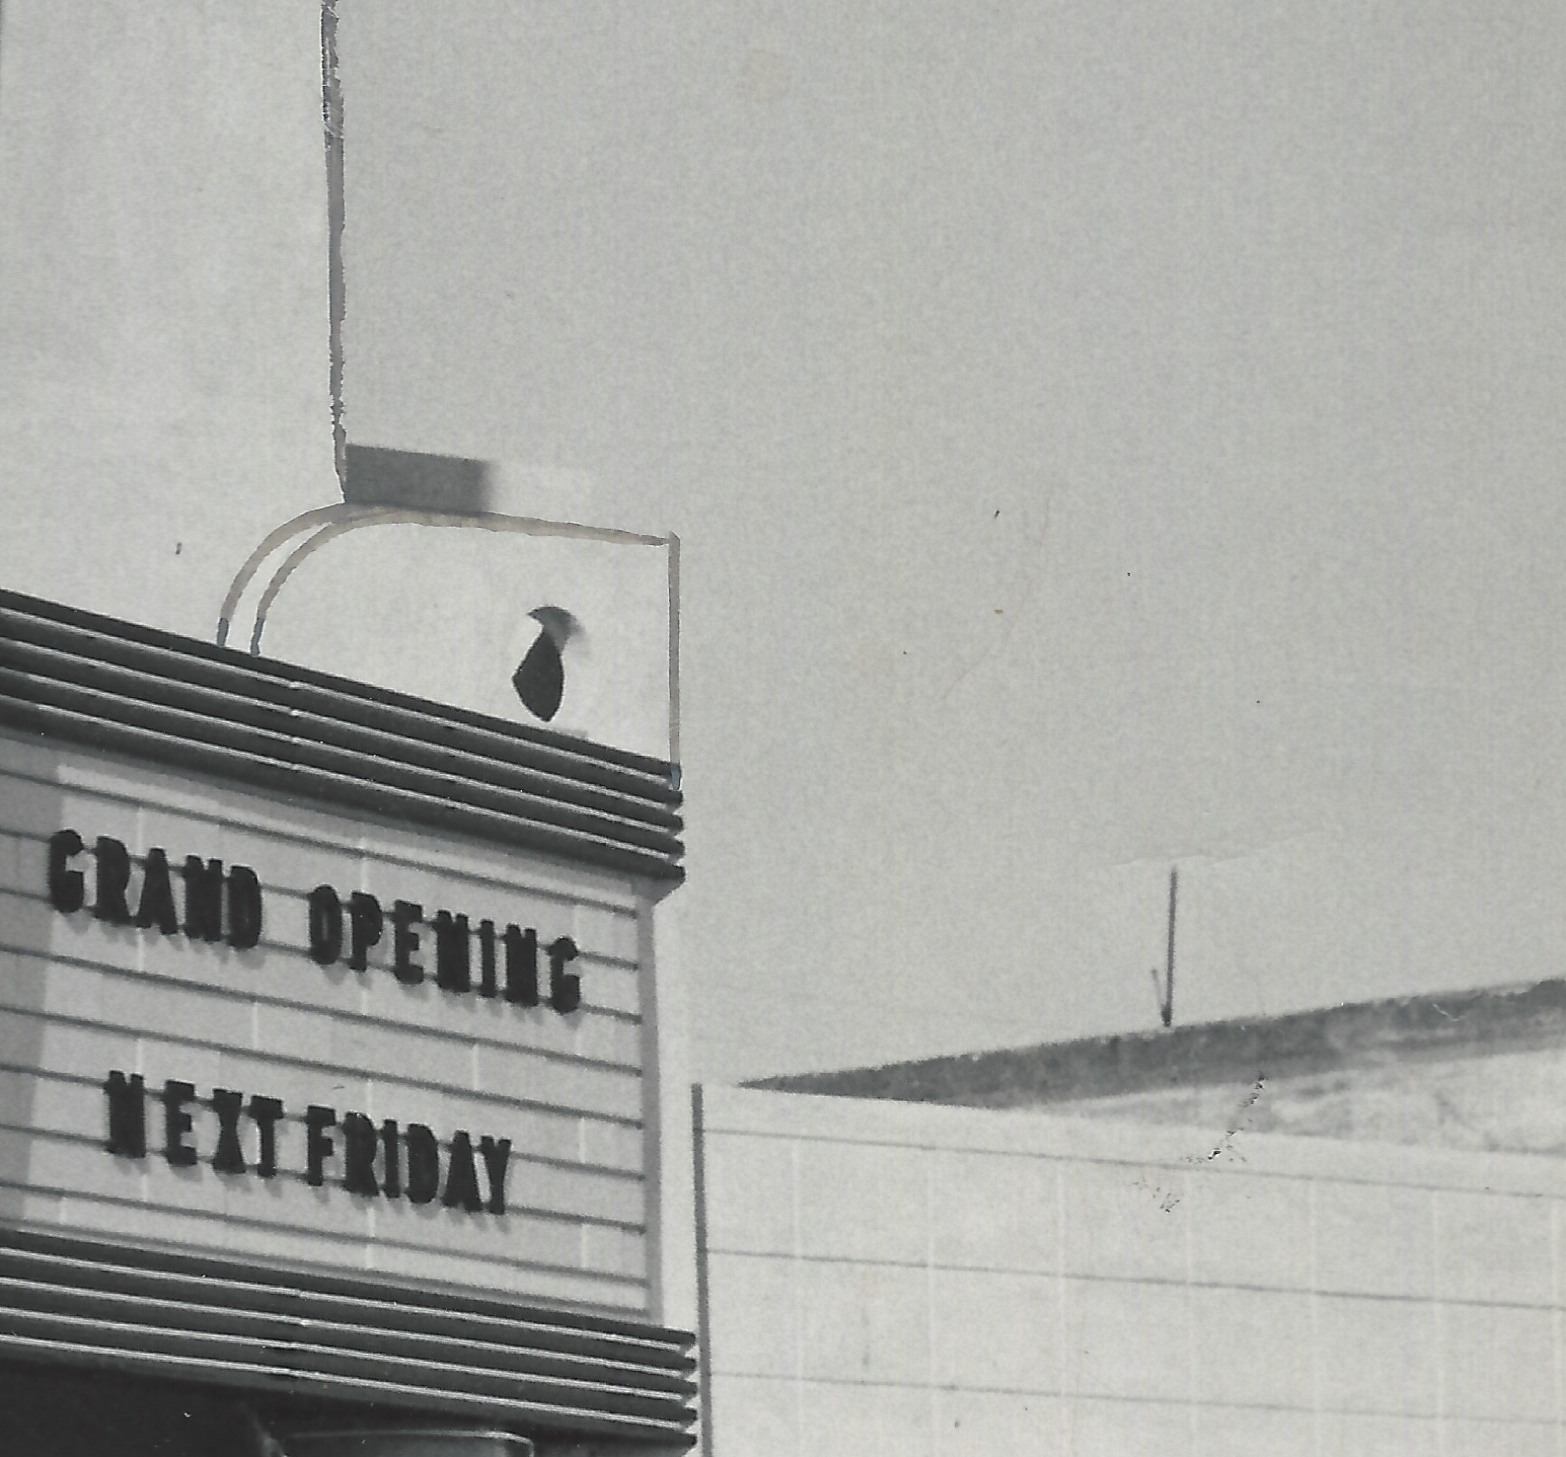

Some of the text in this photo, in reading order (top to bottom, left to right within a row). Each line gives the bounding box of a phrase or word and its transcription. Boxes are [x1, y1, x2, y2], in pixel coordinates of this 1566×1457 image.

[45, 829, 582, 1014] GRAND OPENING
[103, 1070, 513, 1216] NEXT FRIDAY
